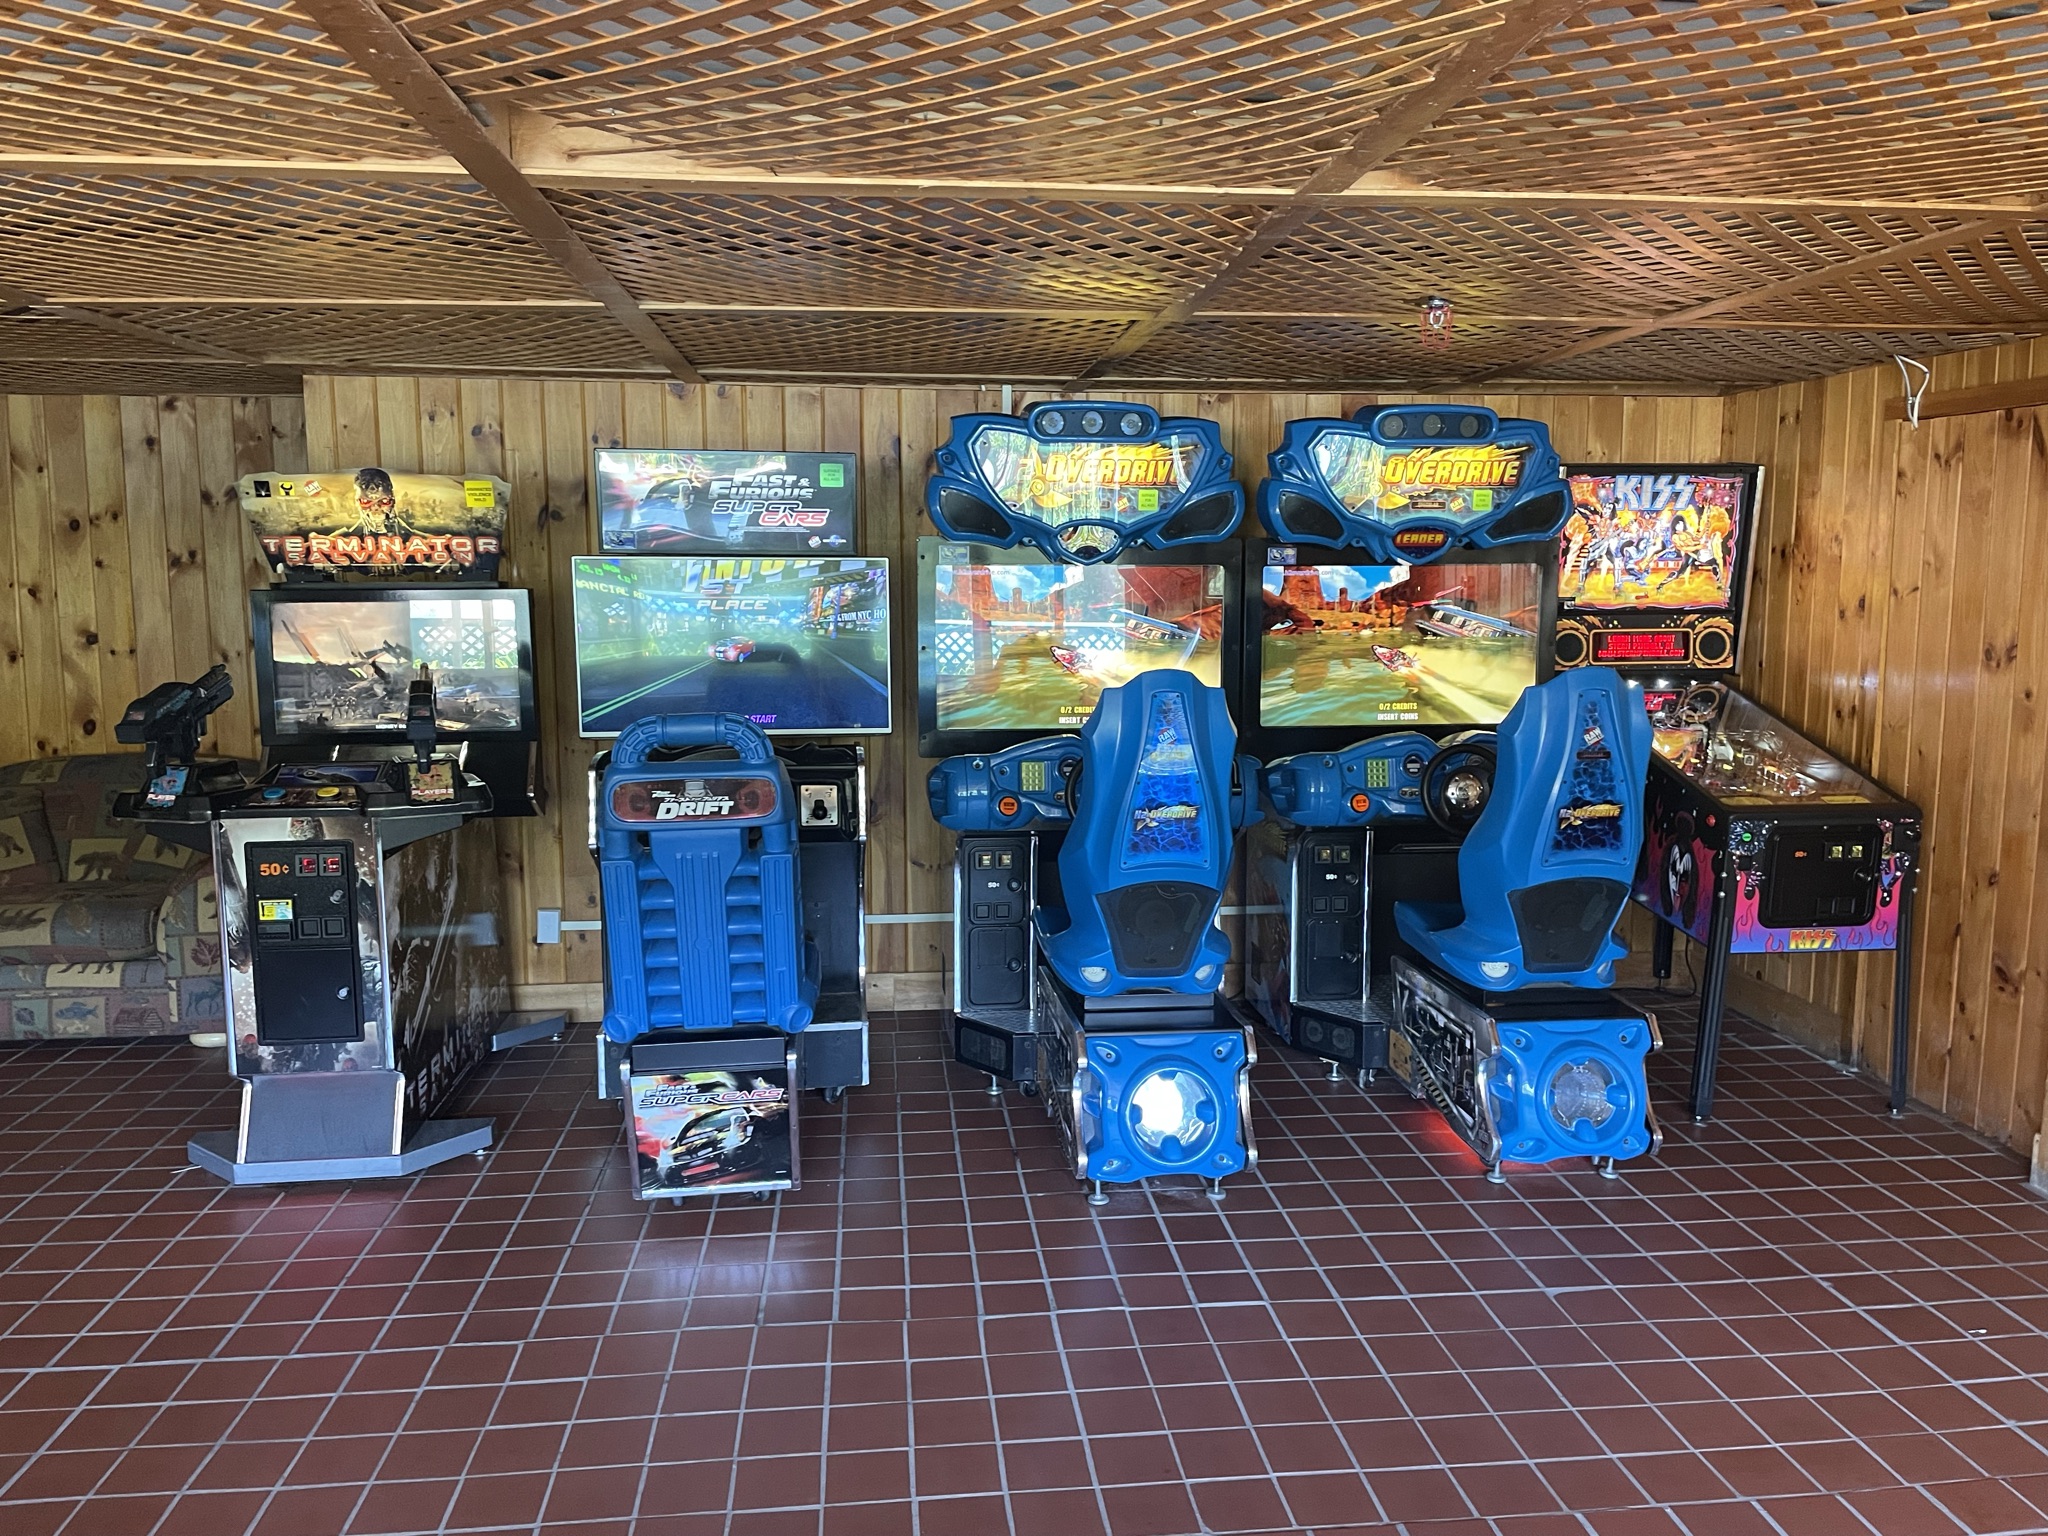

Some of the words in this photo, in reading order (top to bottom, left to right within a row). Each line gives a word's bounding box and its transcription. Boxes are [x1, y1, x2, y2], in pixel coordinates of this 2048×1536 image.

[1384, 454, 1522, 486] OVERDRIVE
[732, 468, 797, 487] FAST
[798, 477, 811, 487] &
[708, 480, 815, 500] FURIOUS
[1613, 474, 1696, 511] KISS
[711, 500, 803, 515] SUPER
[759, 511, 831, 527] CARS
[263, 537, 499, 553] TERMINATOR
[287, 552, 474, 564] SALVATION
[697, 600, 769, 611] PLACE
[858, 611, 872, 621] NYC
[1060, 706, 1073, 714] 0/2
[1074, 706, 1096, 714] CREDIT
[1379, 703, 1391, 711] 0/2
[1392, 703, 1418, 711] CREDITS
[750, 714, 777, 723] START
[1058, 716, 1082, 724] INSERT
[1377, 712, 1399, 721] INSERT
[1400, 712, 1419, 721] COINS
[411, 788, 446, 796] PLAYER
[656, 801, 735, 820] DRIFT
[1149, 809, 1197, 819] OVERDRIVE
[1574, 808, 1620, 818] OVERDRIVE
[259, 862, 290, 876] 50¢
[1789, 929, 1837, 950] KISS
[656, 1084, 688, 1092] FAST
